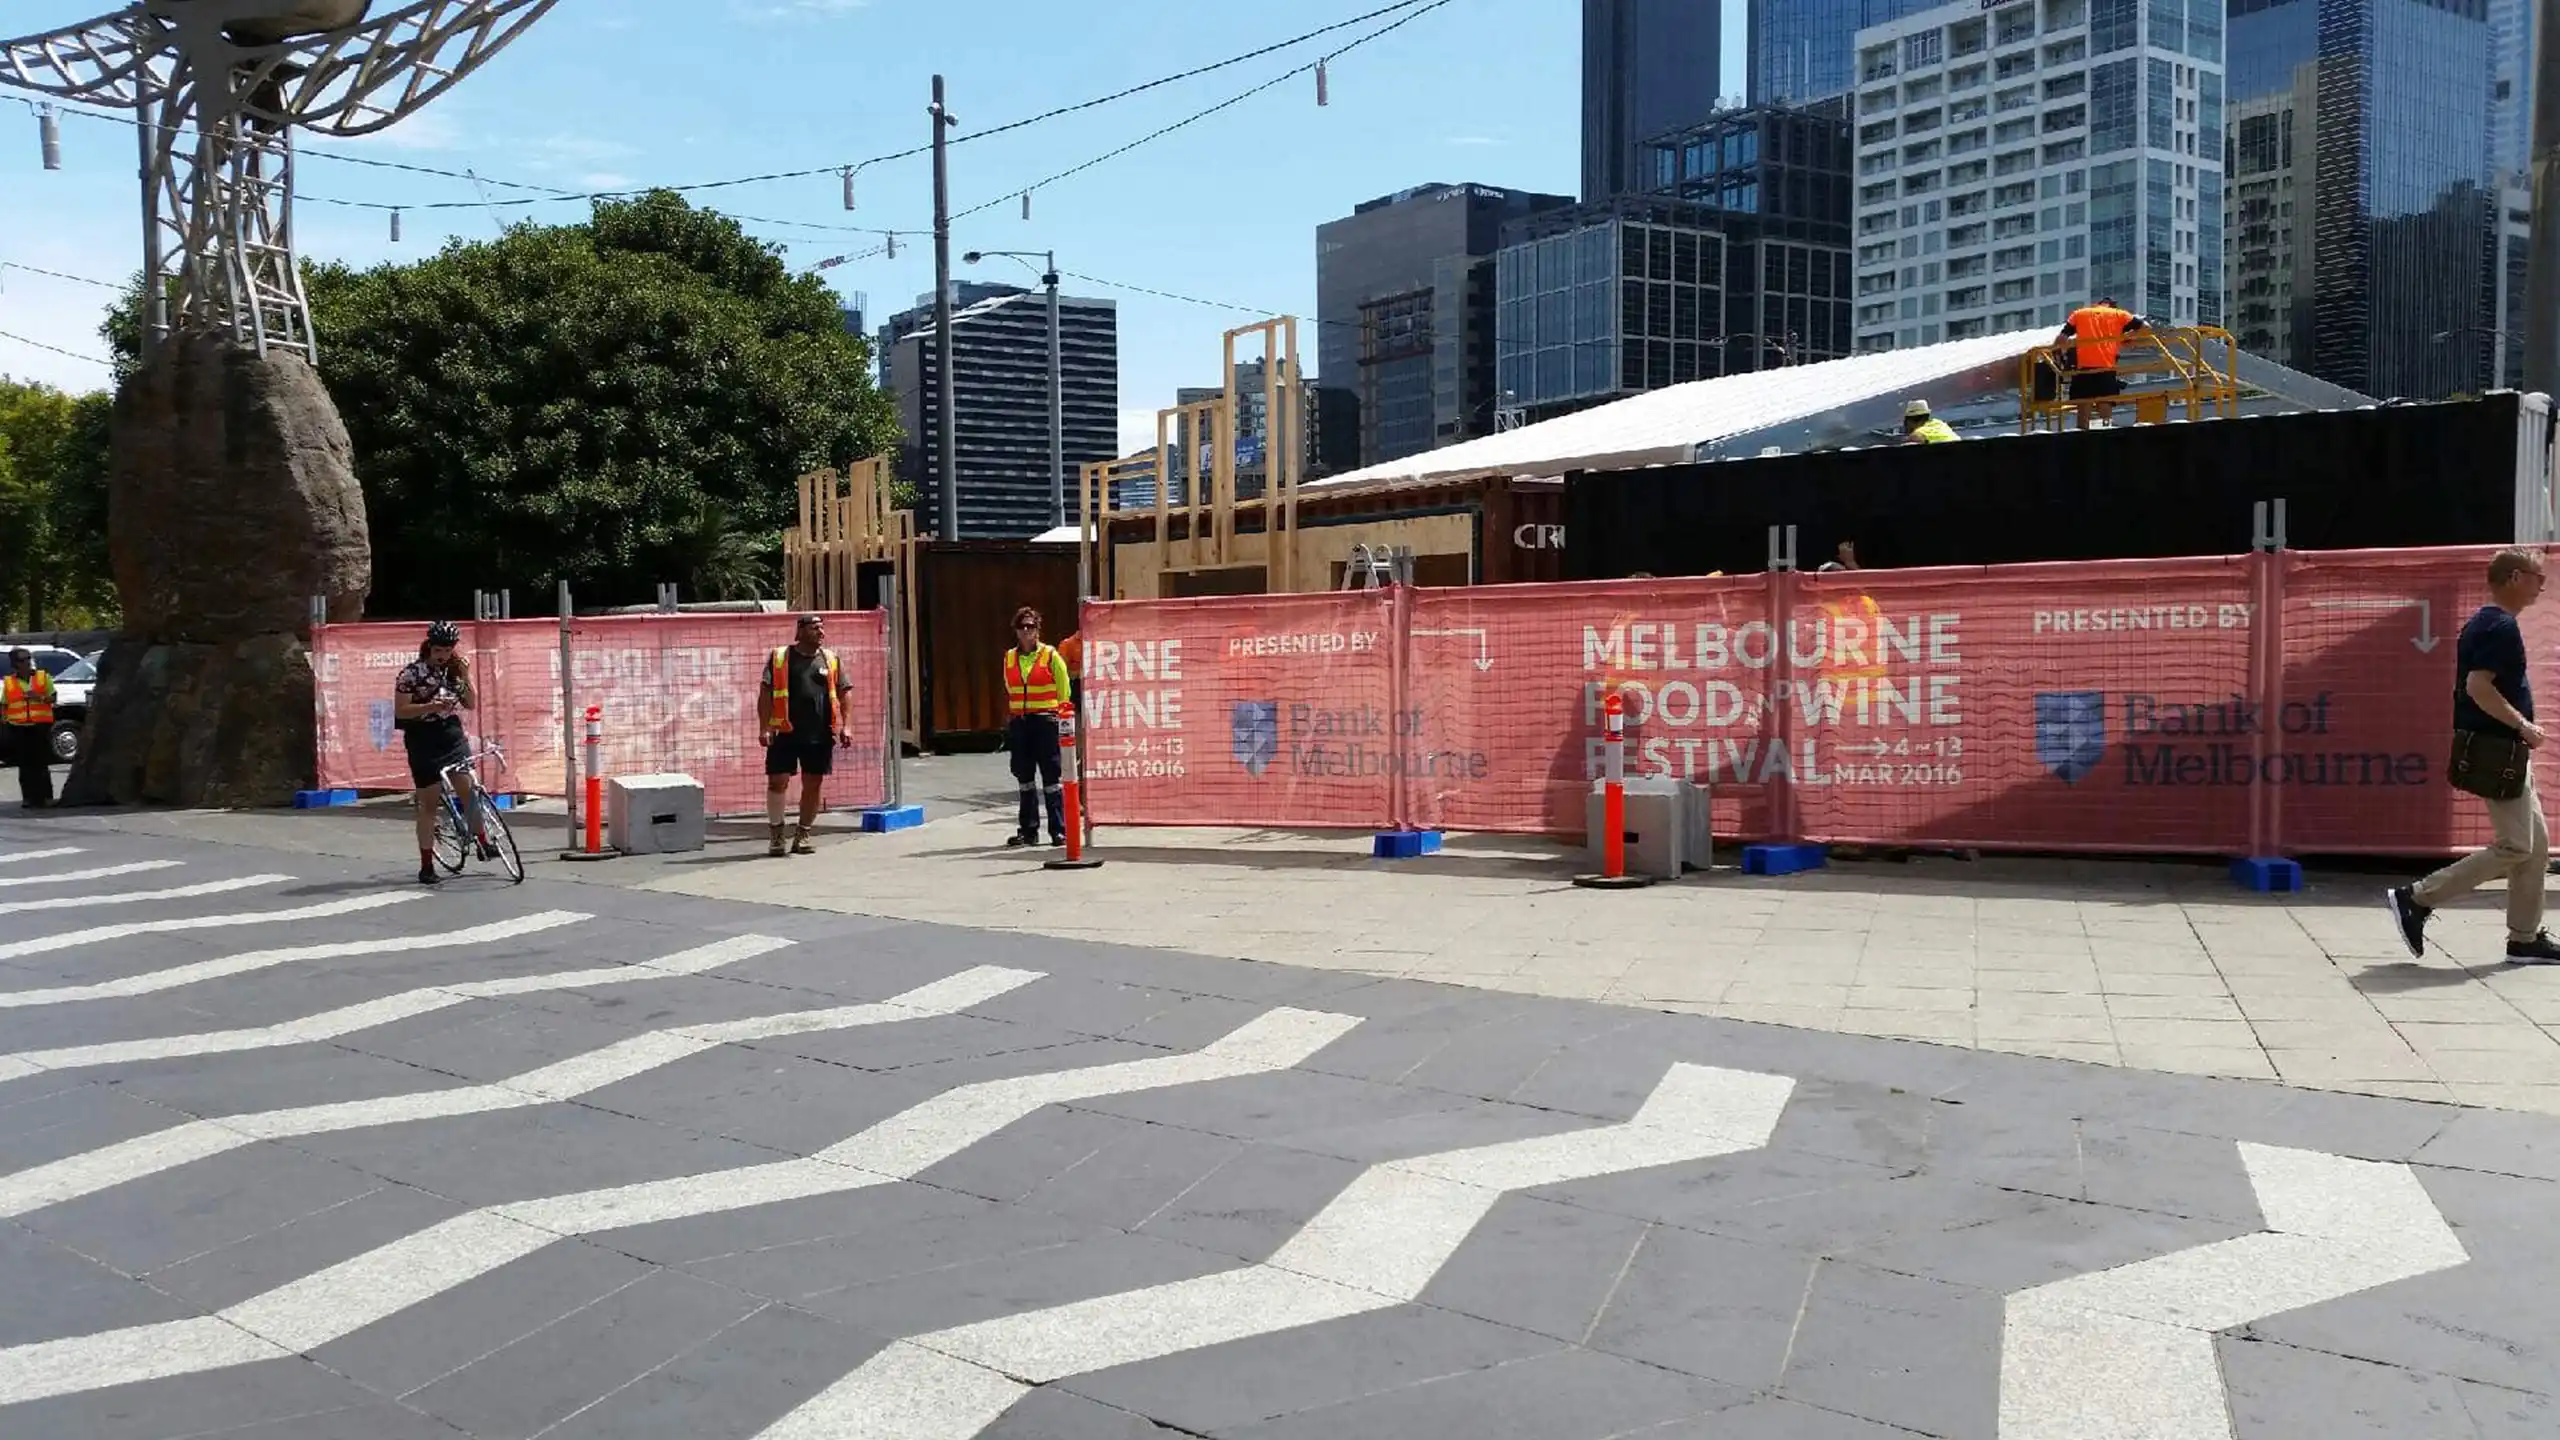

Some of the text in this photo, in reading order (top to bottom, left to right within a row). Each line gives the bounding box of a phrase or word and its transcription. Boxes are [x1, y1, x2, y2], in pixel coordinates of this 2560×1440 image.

[2034, 603, 2257, 633] PRESENTED BY
[1230, 632, 1378, 657] PRESENTED BY
[1583, 614, 1962, 670] MELBOURNE
[1584, 680, 1744, 727] FOOD
[1796, 675, 1962, 726] WINE
[2122, 690, 2334, 737] Bank of
[1290, 703, 1424, 737] Bank of
[1096, 759, 1185, 778] MAR 2016
[1289, 743, 1488, 778] Melbourne
[1584, 737, 1832, 786] FESTIVAL
[1835, 763, 1963, 785] MAR 2016
[2122, 743, 2429, 786] Melbourne
